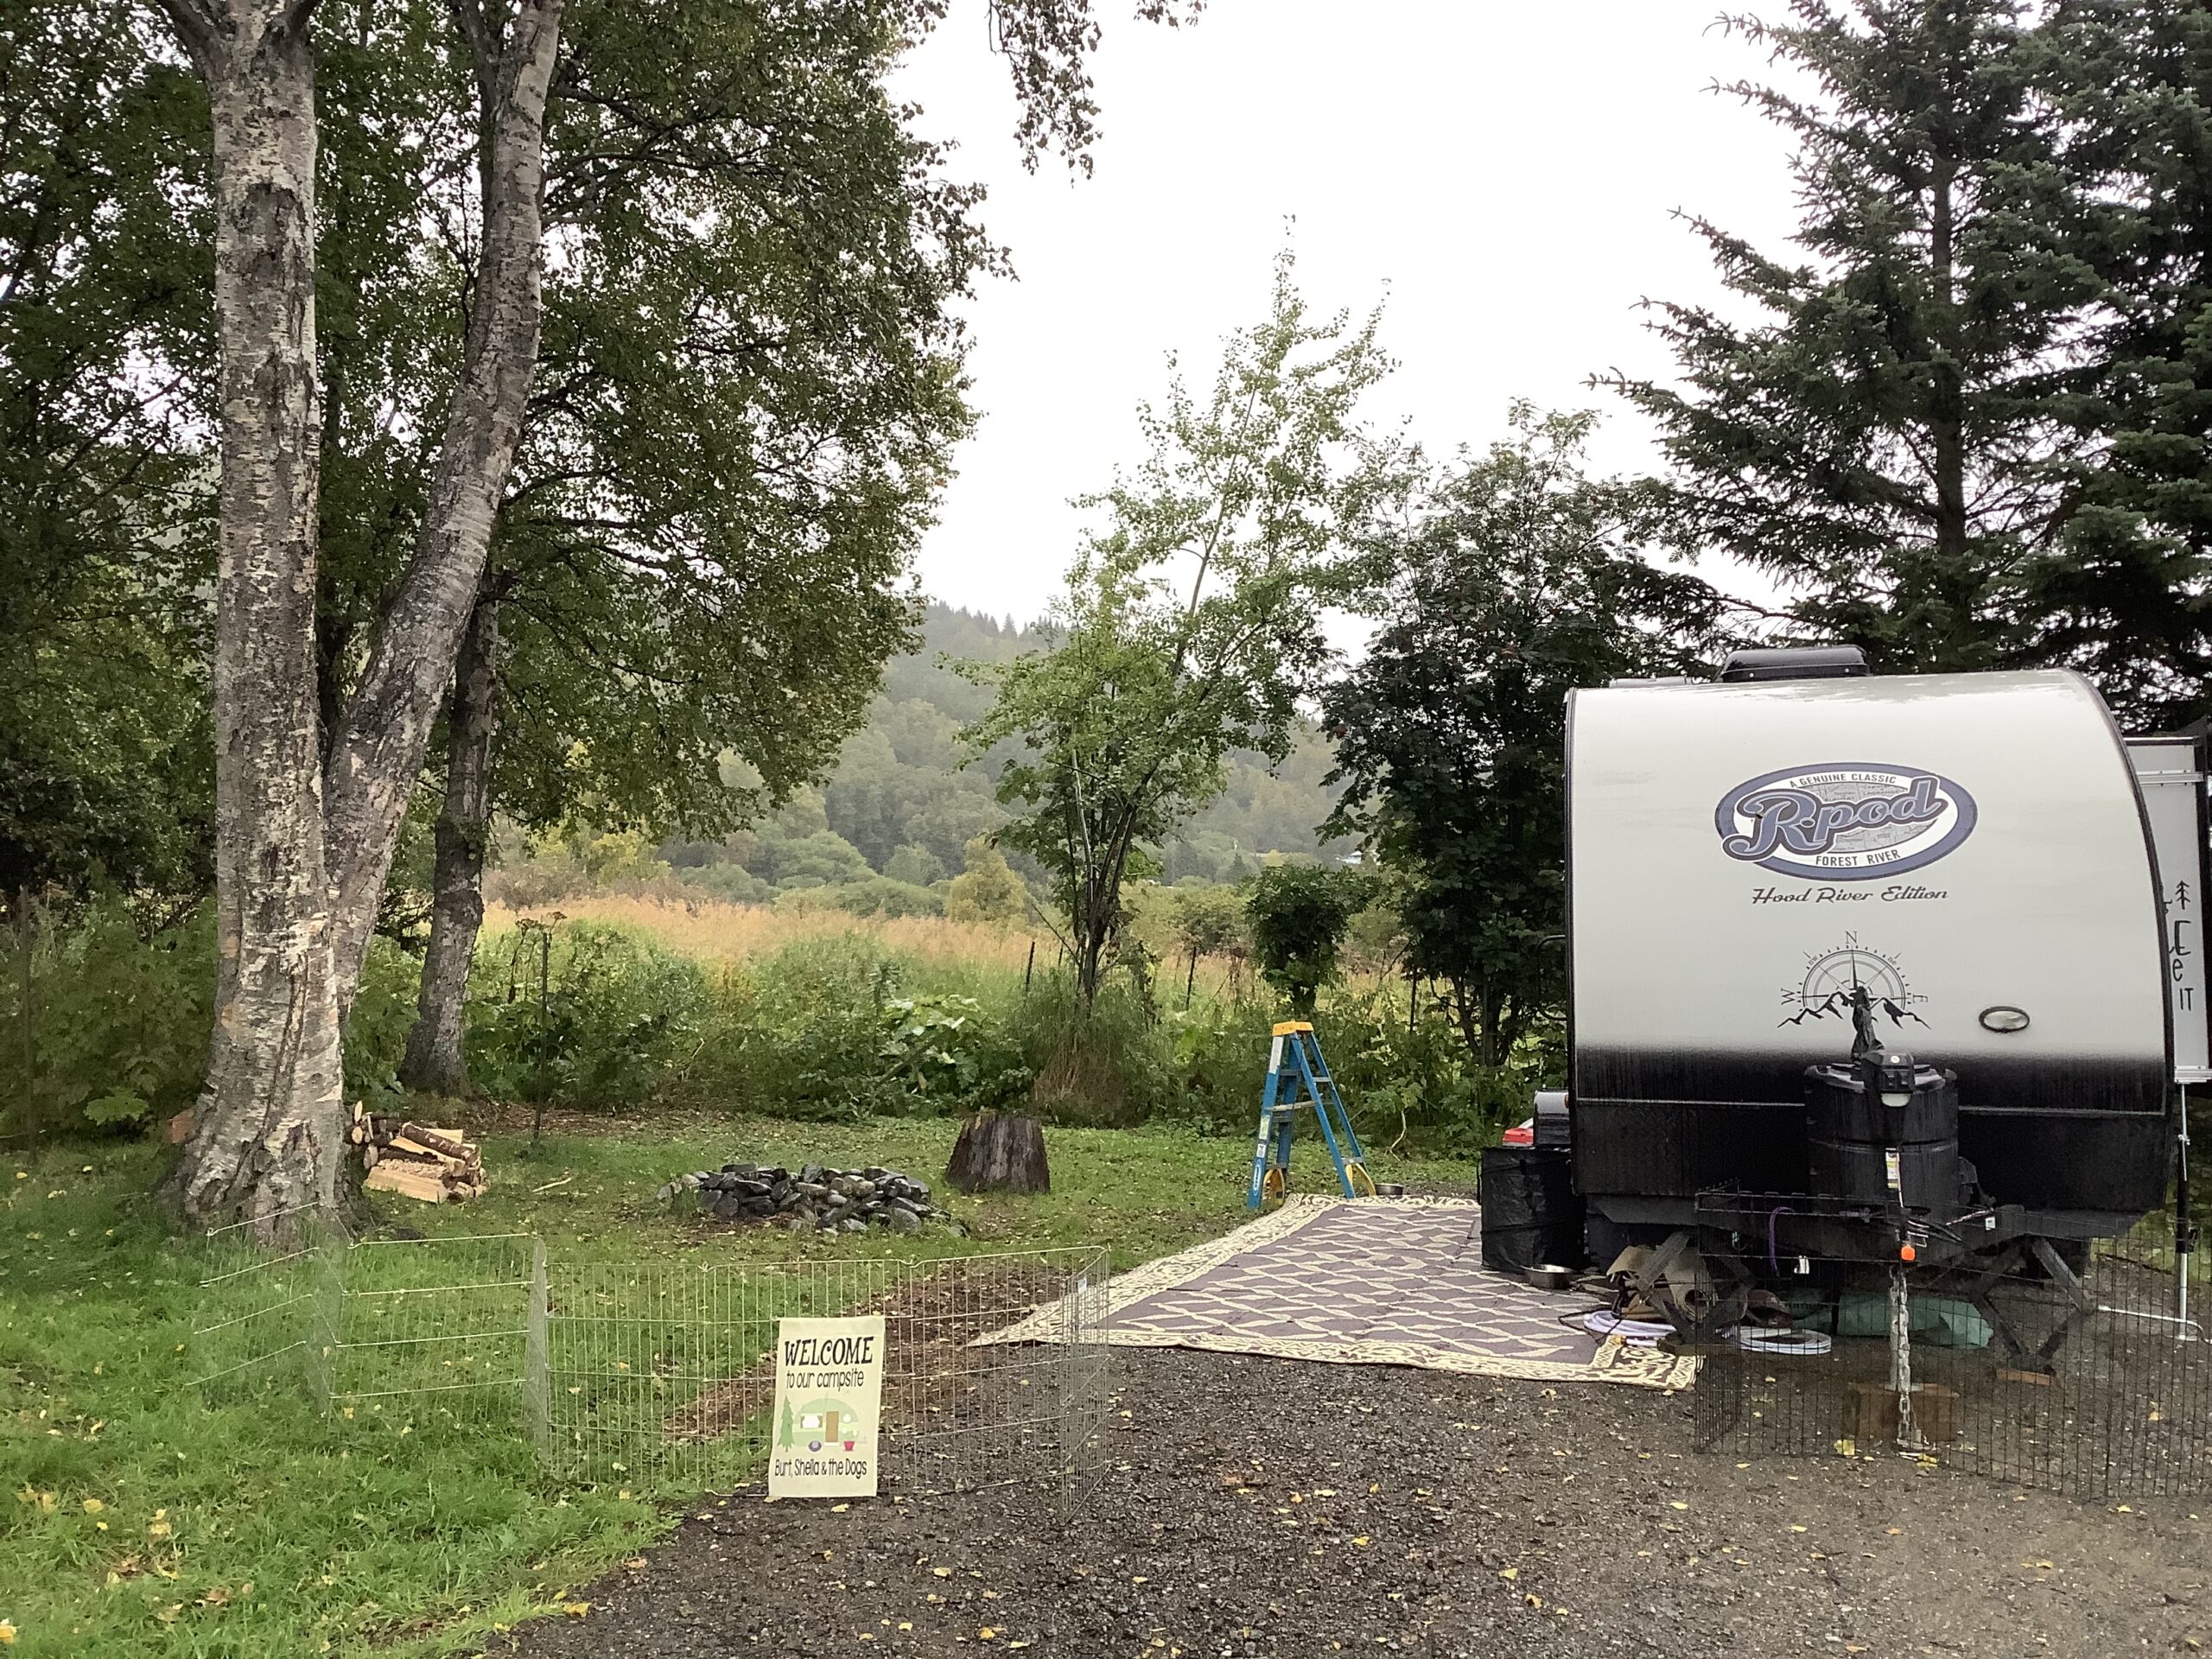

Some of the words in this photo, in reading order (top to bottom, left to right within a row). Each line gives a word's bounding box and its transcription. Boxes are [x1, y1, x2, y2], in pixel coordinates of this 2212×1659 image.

[1799, 773, 1847, 785] GENUINE
[1851, 773, 1897, 784] CLASSIC
[1815, 855, 1858, 867] FOREST
[1866, 849, 1901, 864] RIVER
[1751, 887, 1813, 904] Hood
[1815, 887, 1873, 903] River
[1881, 885, 1948, 902] Edition
[1845, 931, 1858, 944] N
[785, 1336, 874, 1366] WELCOME
[786, 1370, 795, 1389] to
[797, 1371, 815, 1388] our
[817, 1368, 864, 1392] campsite
[821, 1461, 828, 1475] &
[829, 1459, 844, 1475] the
[845, 1458, 868, 1479] Dogs
